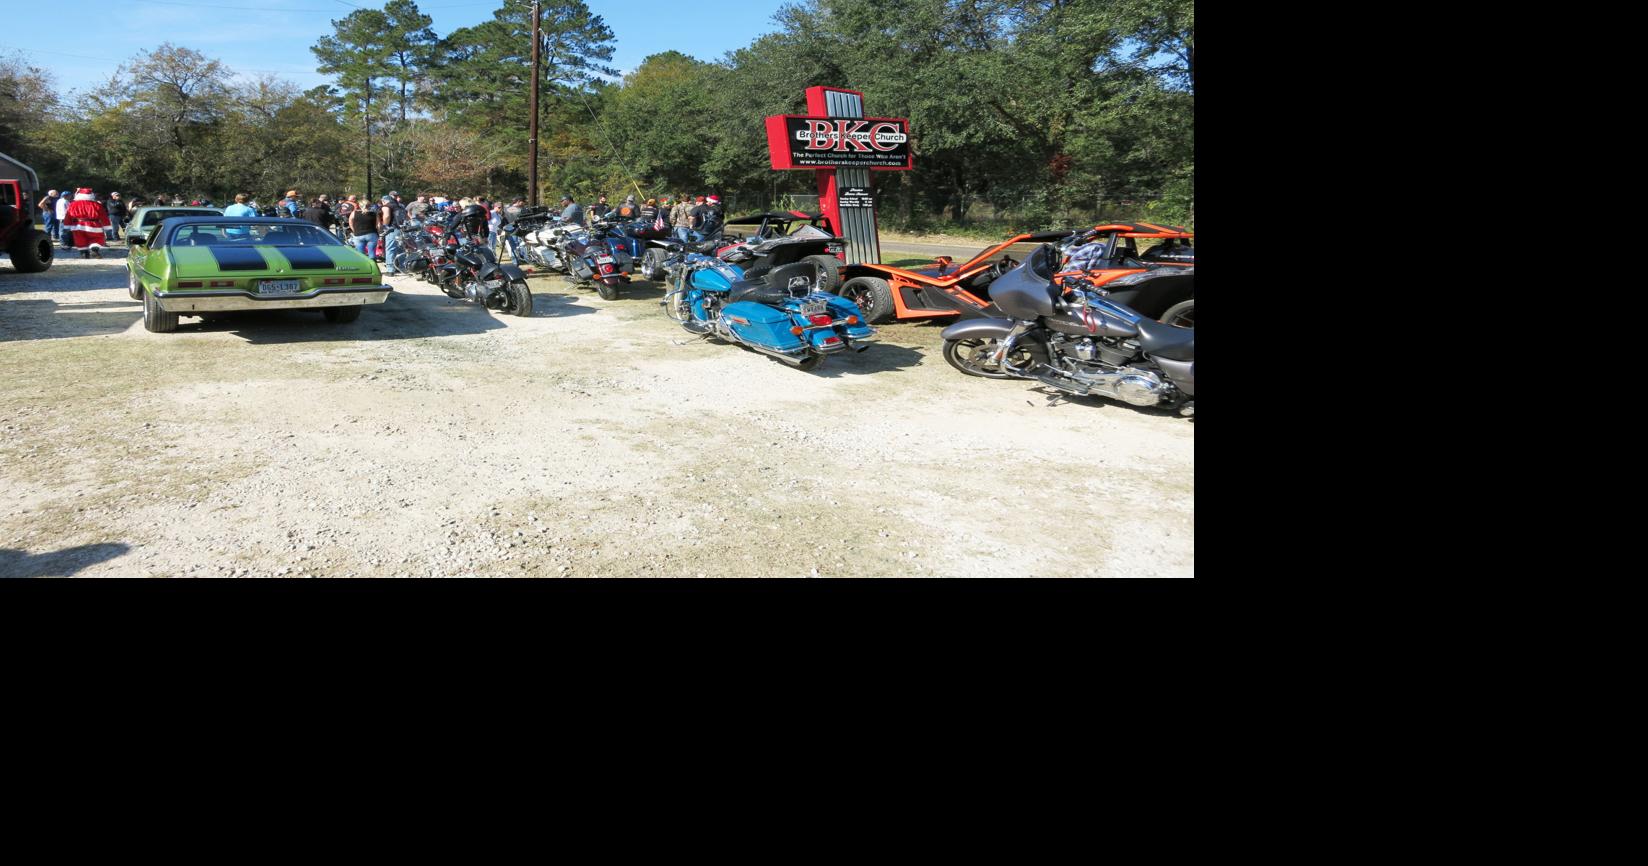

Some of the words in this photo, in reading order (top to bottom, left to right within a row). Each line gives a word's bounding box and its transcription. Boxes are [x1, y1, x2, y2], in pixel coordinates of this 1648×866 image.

[799, 130, 838, 140] Brothers
[840, 132, 872, 142] Keeper
[875, 132, 905, 142] Church
[804, 119, 900, 152] BKC
